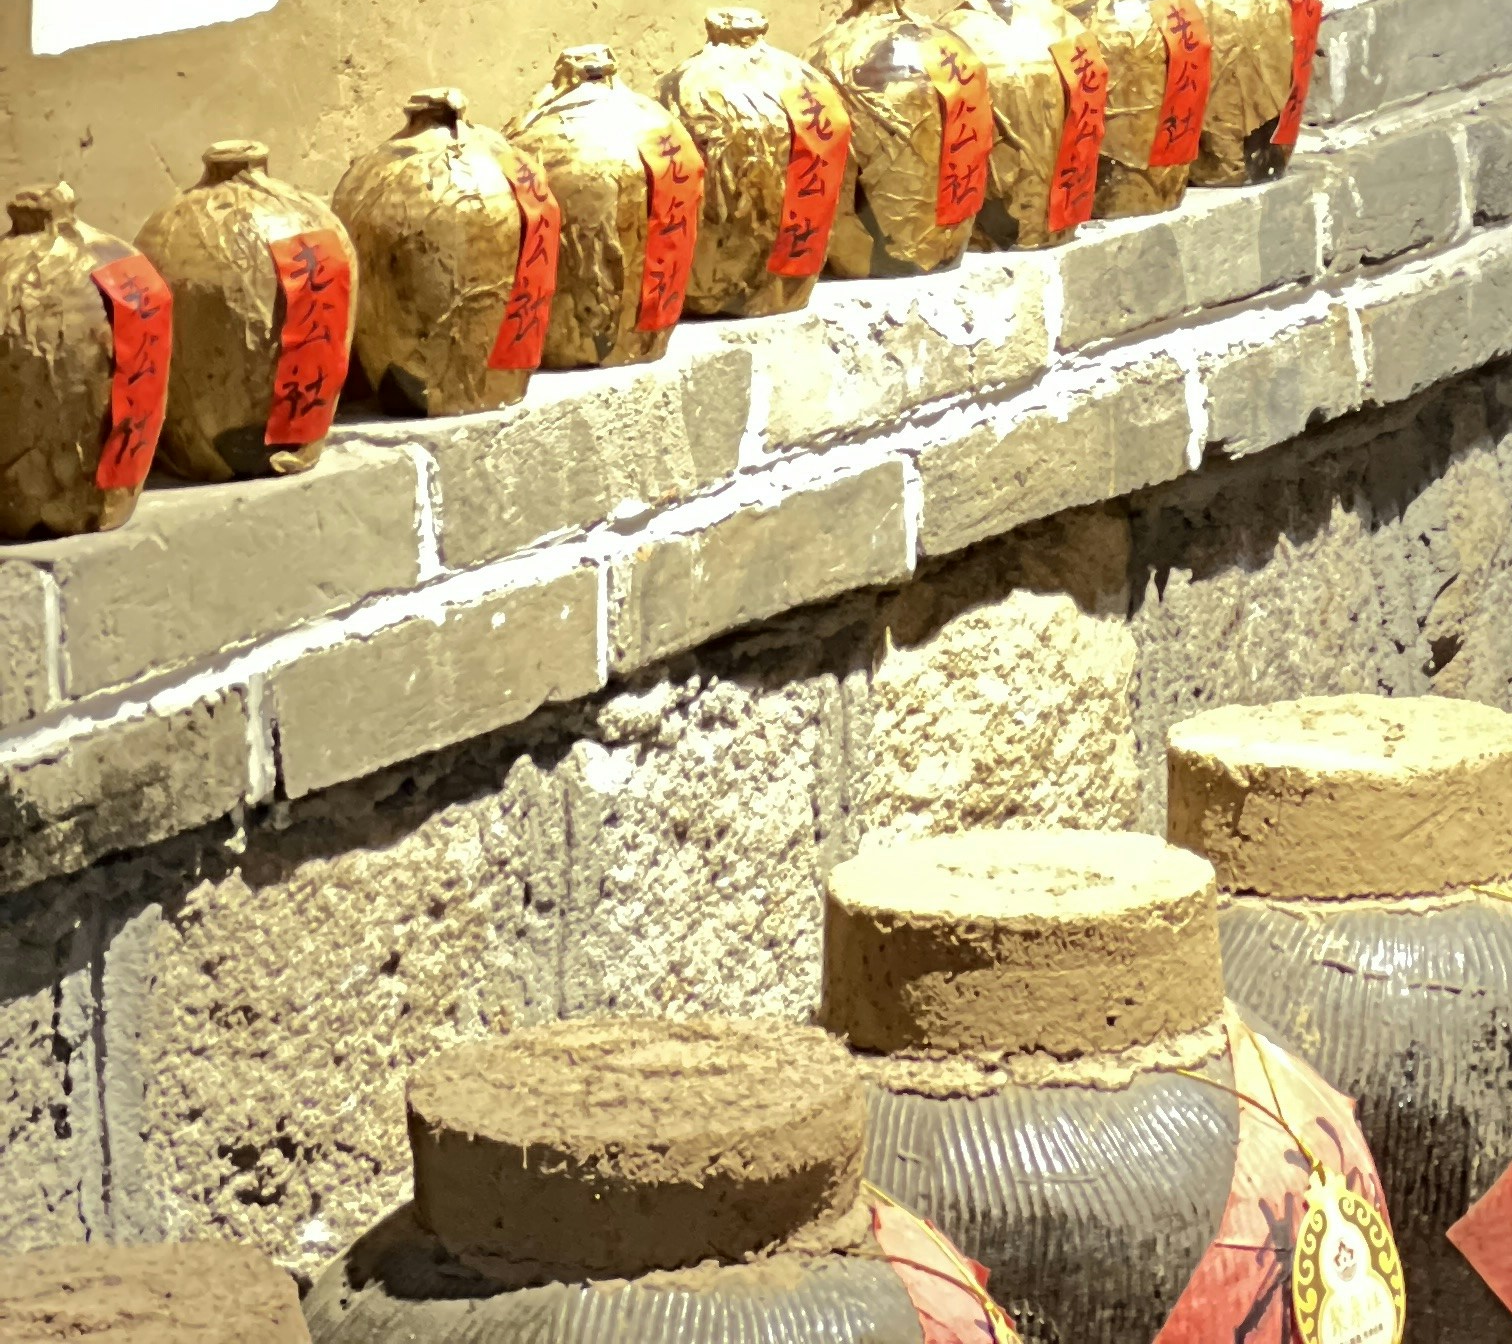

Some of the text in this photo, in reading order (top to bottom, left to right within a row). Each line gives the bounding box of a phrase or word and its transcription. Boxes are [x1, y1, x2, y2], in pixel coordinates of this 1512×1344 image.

[940, 48, 982, 207] 老公社
[1058, 47, 1100, 210] 老公社
[1159, 7, 1200, 150] 老公社
[641, 134, 690, 314] 老公社
[782, 90, 832, 258] 老公社
[107, 275, 159, 470] 老公社
[271, 244, 336, 418] 老公社
